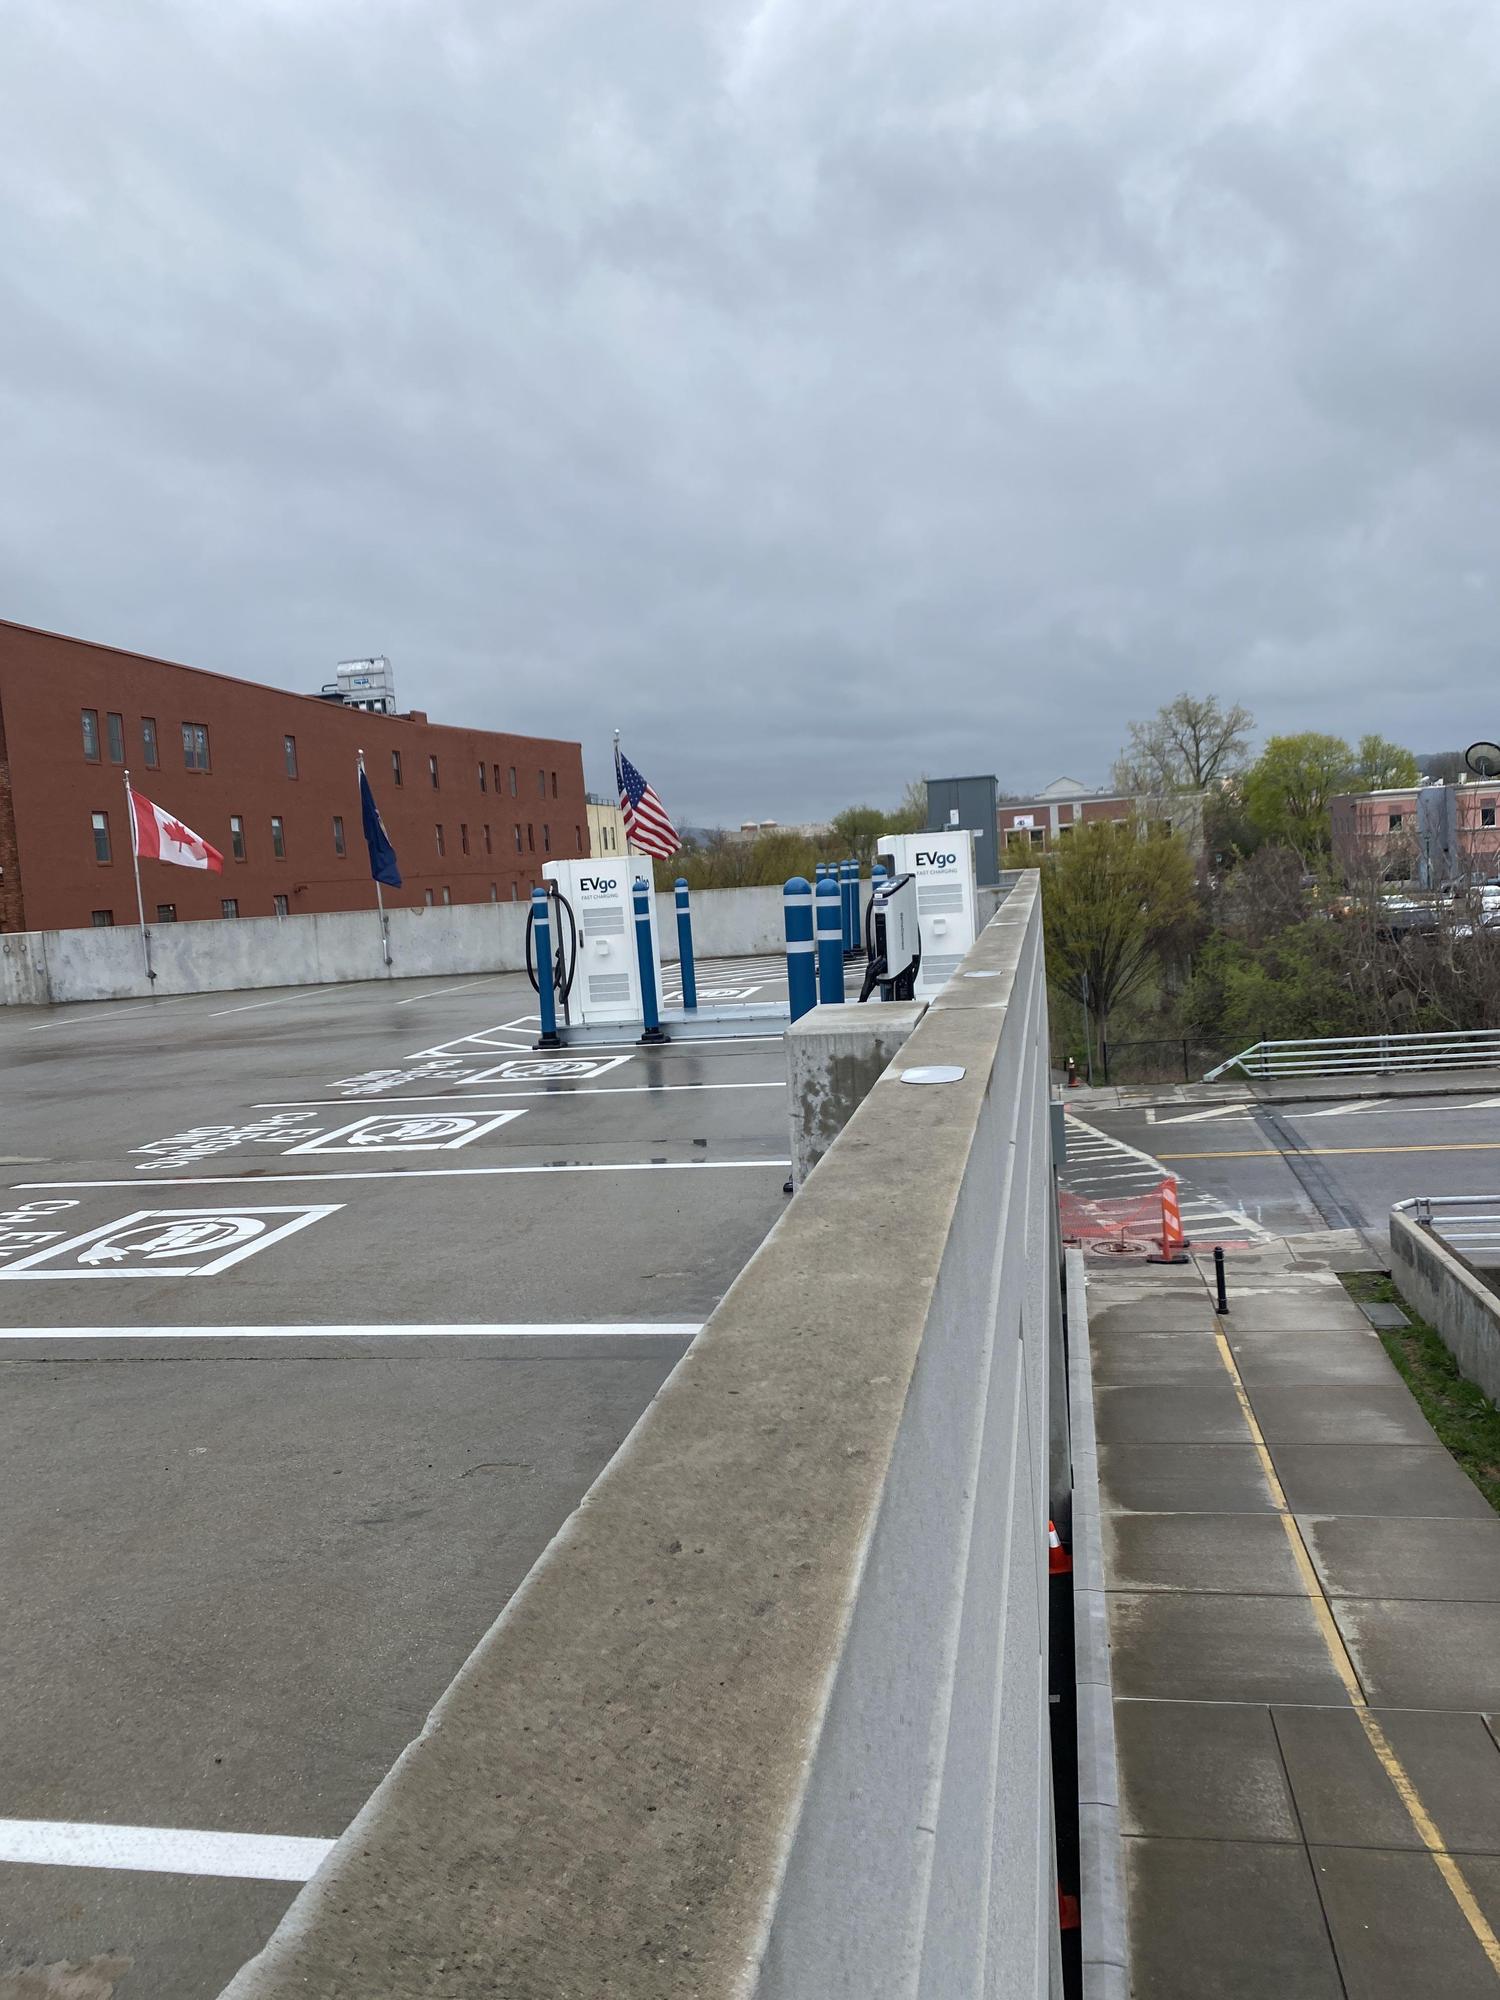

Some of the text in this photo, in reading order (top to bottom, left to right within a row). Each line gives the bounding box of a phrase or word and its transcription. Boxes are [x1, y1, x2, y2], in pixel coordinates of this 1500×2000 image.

[916, 851, 956, 868] EVgo
[580, 876, 617, 893] EVgo
[127, 1125, 236, 1155] ONLY
[135, 1111, 318, 1170] CHARGING
[254, 1128, 325, 1143] EV
